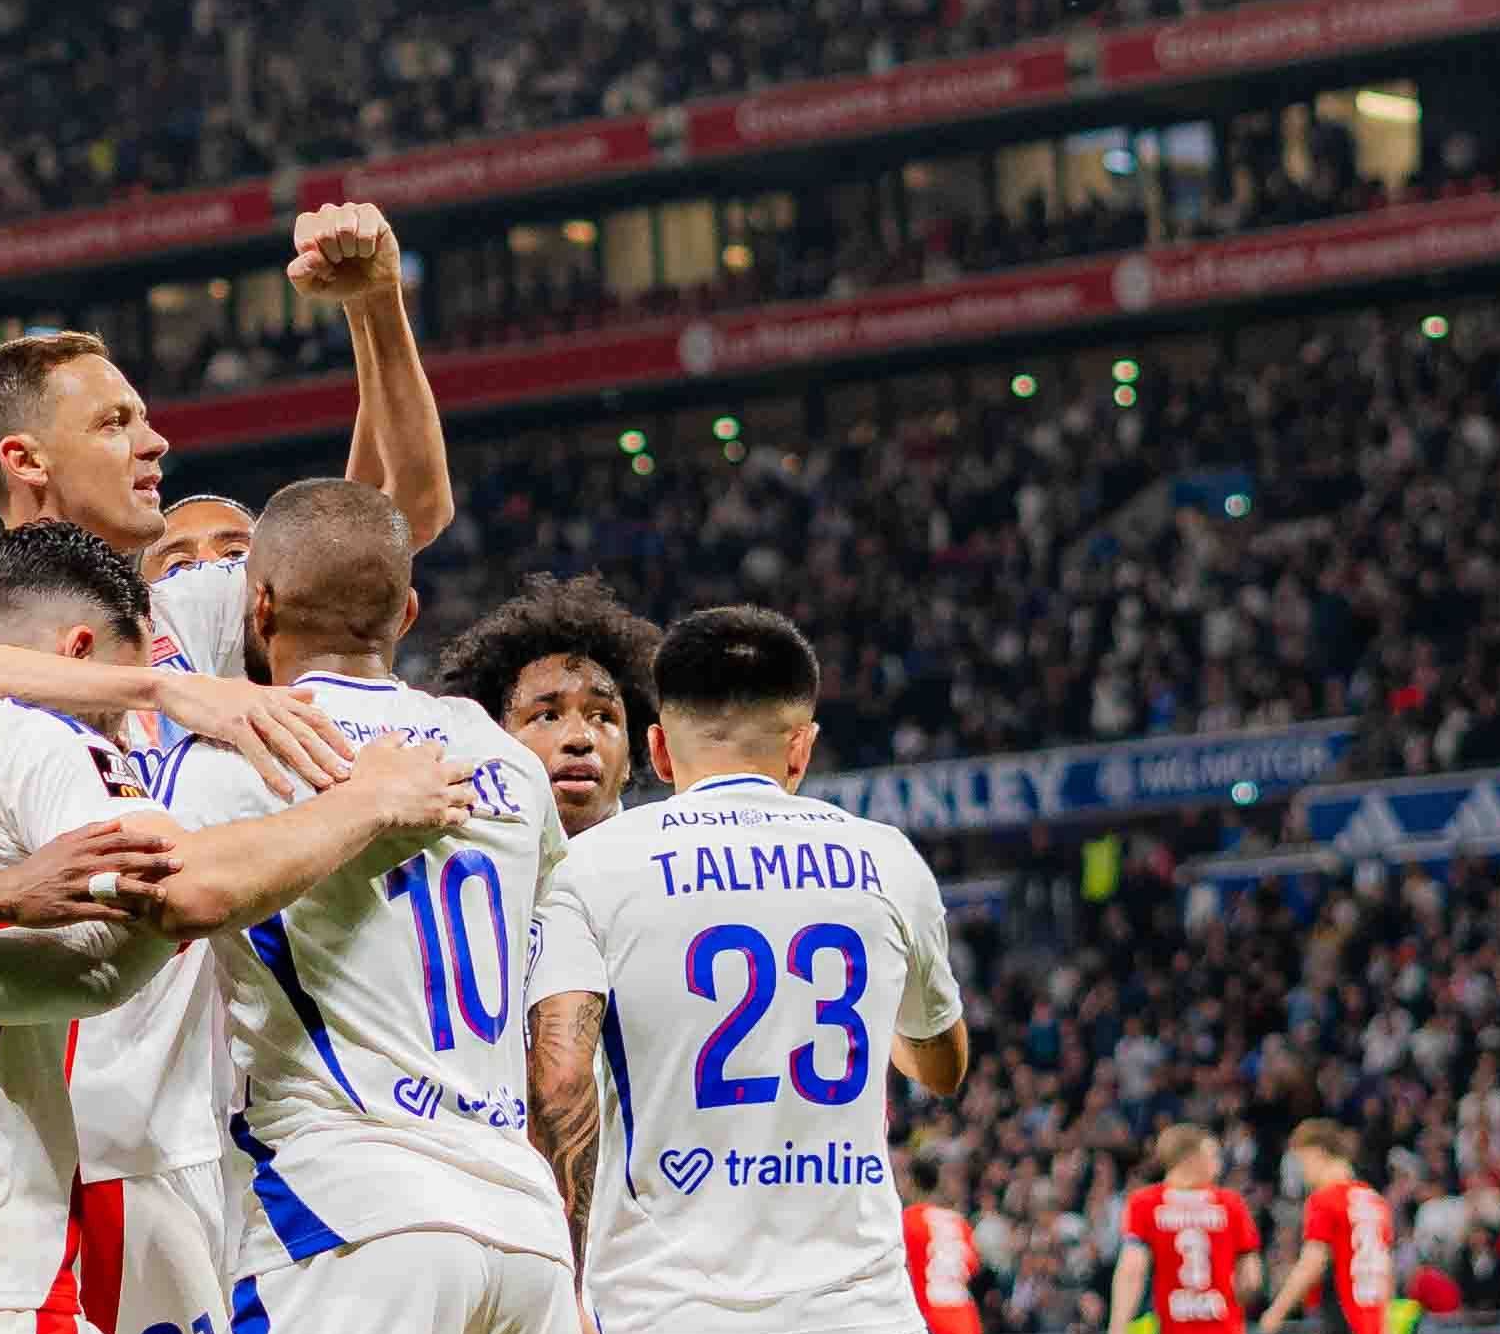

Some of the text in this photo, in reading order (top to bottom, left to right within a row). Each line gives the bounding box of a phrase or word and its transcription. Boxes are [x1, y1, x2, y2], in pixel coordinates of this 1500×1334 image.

[386, 850, 510, 1053] 10
[650, 843, 882, 896] T.ALMADA
[686, 923, 868, 1109] 23
